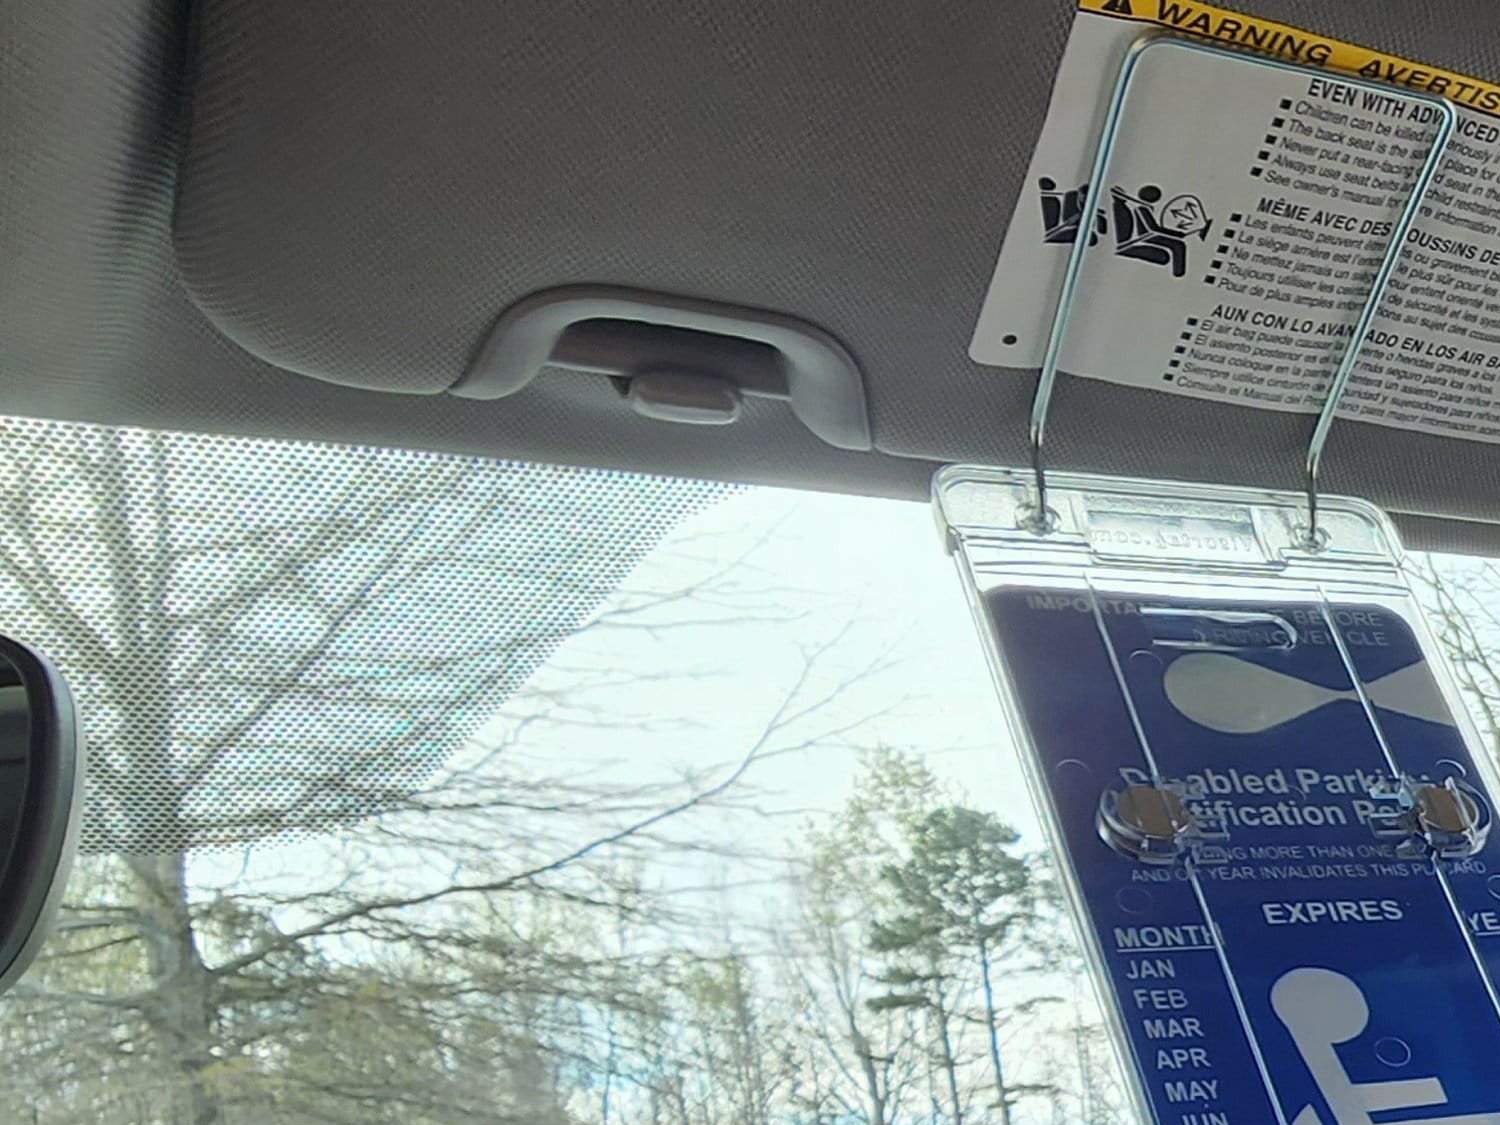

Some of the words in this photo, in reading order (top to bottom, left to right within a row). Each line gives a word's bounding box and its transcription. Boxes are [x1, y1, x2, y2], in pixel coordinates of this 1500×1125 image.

[1156, 0, 1333, 65] WARNING
[1307, 77, 1357, 106] EVEN
[1359, 91, 1406, 118] WITH
[1406, 104, 1500, 143] ADVNCED
[1294, 100, 1350, 125] Children
[1349, 116, 1374, 131] can
[1375, 119, 1393, 135] be
[1394, 124, 1425, 143] killed
[1442, 139, 1492, 167] eriously
[1288, 119, 1315, 137] The
[1314, 125, 1345, 144] back
[1346, 132, 1375, 151] seat
[1376, 139, 1388, 154] is
[1389, 143, 1408, 158] the
[1442, 157, 1479, 180] place
[1479, 166, 1496, 182] for
[1270, 152, 1317, 177] Always
[1317, 166, 1341, 180] use
[1342, 168, 1371, 186] seat
[1371, 175, 1400, 192] belts
[1423, 188, 1453, 206] child
[1278, 136, 1319, 157] Never
[1318, 145, 1339, 164] put
[1340, 153, 1350, 164] a
[1352, 153, 1413, 180] rear-facing
[1444, 175, 1471, 193] seat
[1471, 183, 1484, 197] in
[1264, 169, 1292, 186] See
[1292, 178, 1340, 197] owner's
[1257, 193, 1310, 221] MÊME
[1310, 208, 1358, 231] AVEC
[1359, 218, 1393, 237] DES
[1405, 227, 1478, 259] OUSSINS
[1210, 304, 1247, 323] AUN
[1250, 311, 1287, 330] CON
[1290, 318, 1314, 334] LO
[1315, 321, 1399, 347] AVANADO
[1401, 336, 1424, 352] EN
[1425, 341, 1457, 359] LOS
[1458, 348, 1486, 365] AIR
[1119, 767, 1288, 794] Dabled
[1251, 845, 1304, 861] MORE
[1308, 845, 1354, 860] THAN
[1358, 844, 1394, 858] ONE
[1131, 869, 1170, 883] AND
[1207, 866, 1256, 881] YEAR
[1261, 863, 1368, 880] INVALIDATES
[1370, 864, 1409, 878] THIS
[1262, 900, 1403, 924] EXPIRES
[1126, 959, 1175, 979] JAN
[1133, 989, 1188, 1010] FEB
[1143, 1018, 1204, 1039] MAR
[1157, 1048, 1211, 1070] APR
[1165, 1080, 1217, 1102] MAY
